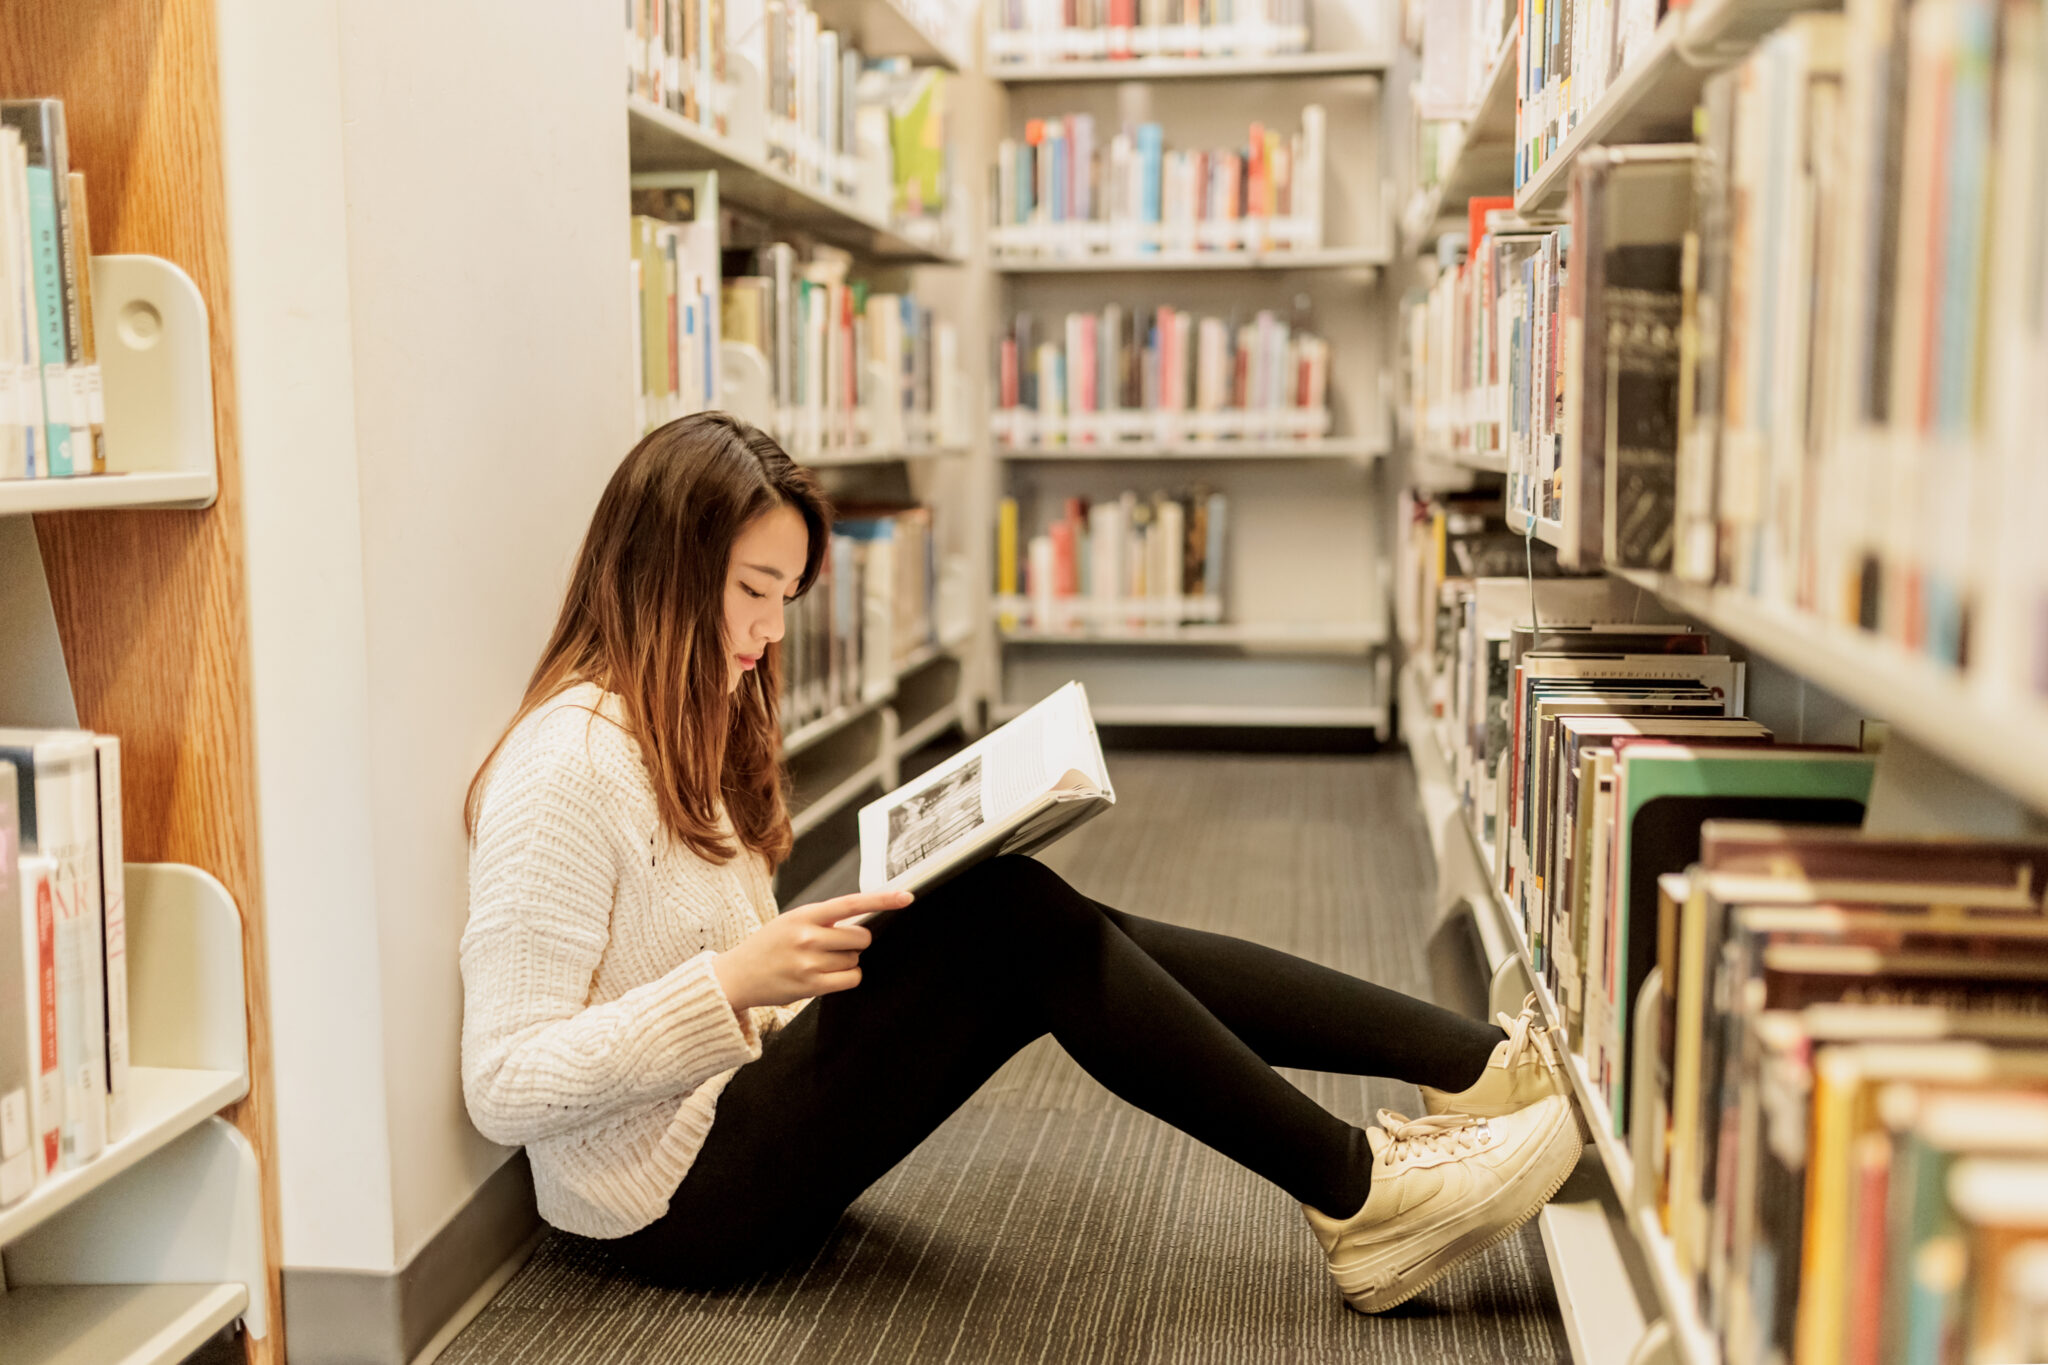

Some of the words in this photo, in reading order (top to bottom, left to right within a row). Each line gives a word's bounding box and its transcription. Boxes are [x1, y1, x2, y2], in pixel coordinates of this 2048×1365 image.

[42, 230, 59, 347] BESTIARY
[1582, 671, 1691, 679] HARPERCOLLINS
[1373, 1263, 1400, 1293] AIR
